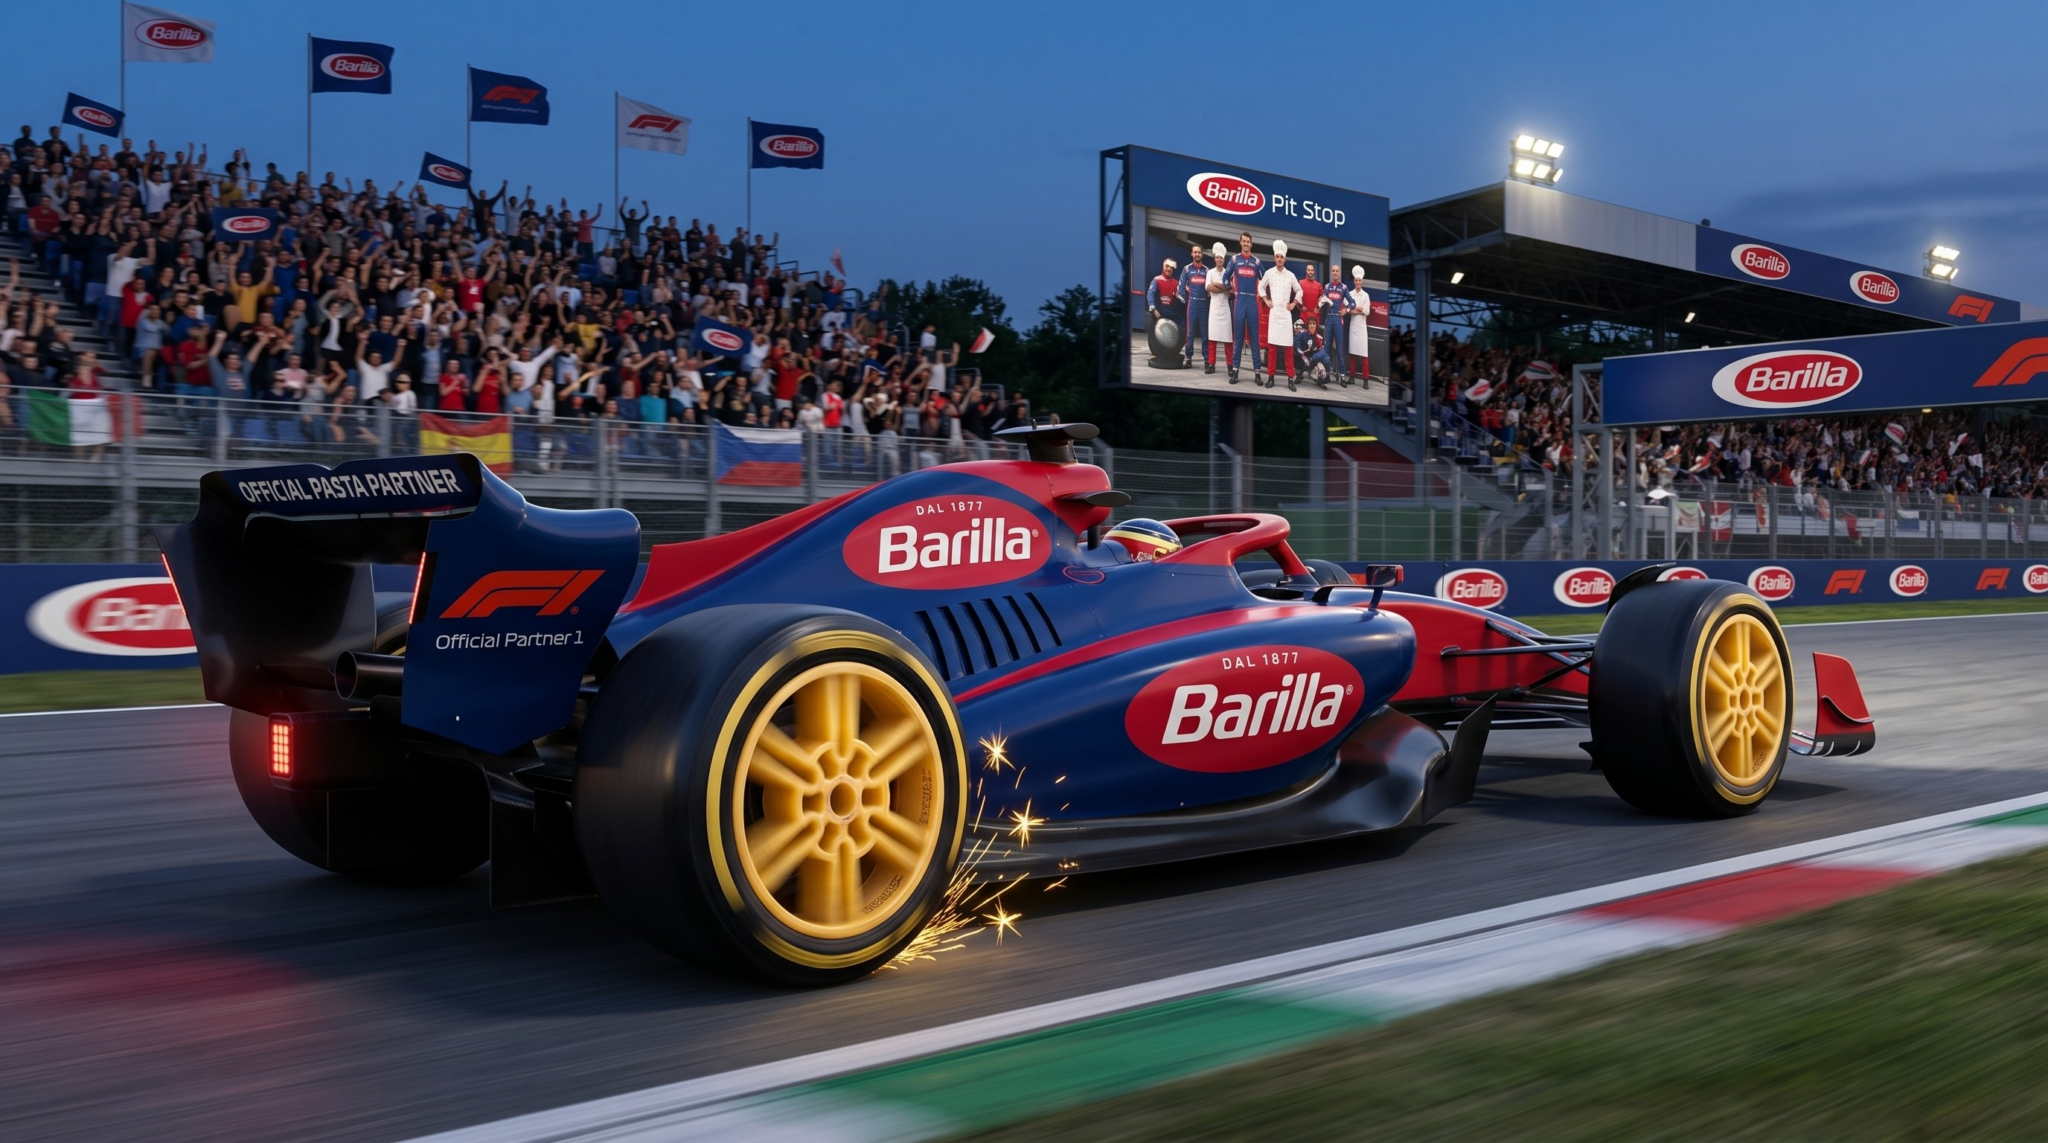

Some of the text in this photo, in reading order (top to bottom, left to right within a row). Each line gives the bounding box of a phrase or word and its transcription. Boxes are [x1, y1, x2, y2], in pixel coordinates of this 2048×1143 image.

[151, 26, 201, 41] Barilla
[334, 59, 380, 73] Barilla
[772, 140, 815, 152] Barilla
[1205, 181, 1346, 228] Barilla Pit Stop
[1744, 251, 1786, 273] Barilla
[1861, 277, 1896, 297] Barilla
[1745, 361, 1848, 393] Barilla
[238, 468, 463, 503] OFFICIAL PASTA PARTNER
[916, 501, 983, 516] DAL 1877
[878, 517, 1031, 574] Barilla
[1452, 579, 1502, 599] Barilla
[1568, 577, 1612, 596] Barilla
[1758, 574, 1792, 591] Barilla
[1898, 572, 1926, 588] Barilla
[435, 633, 500, 650] Official
[1222, 652, 1299, 670] DAL 1877
[1161, 672, 1345, 745] Barilla
